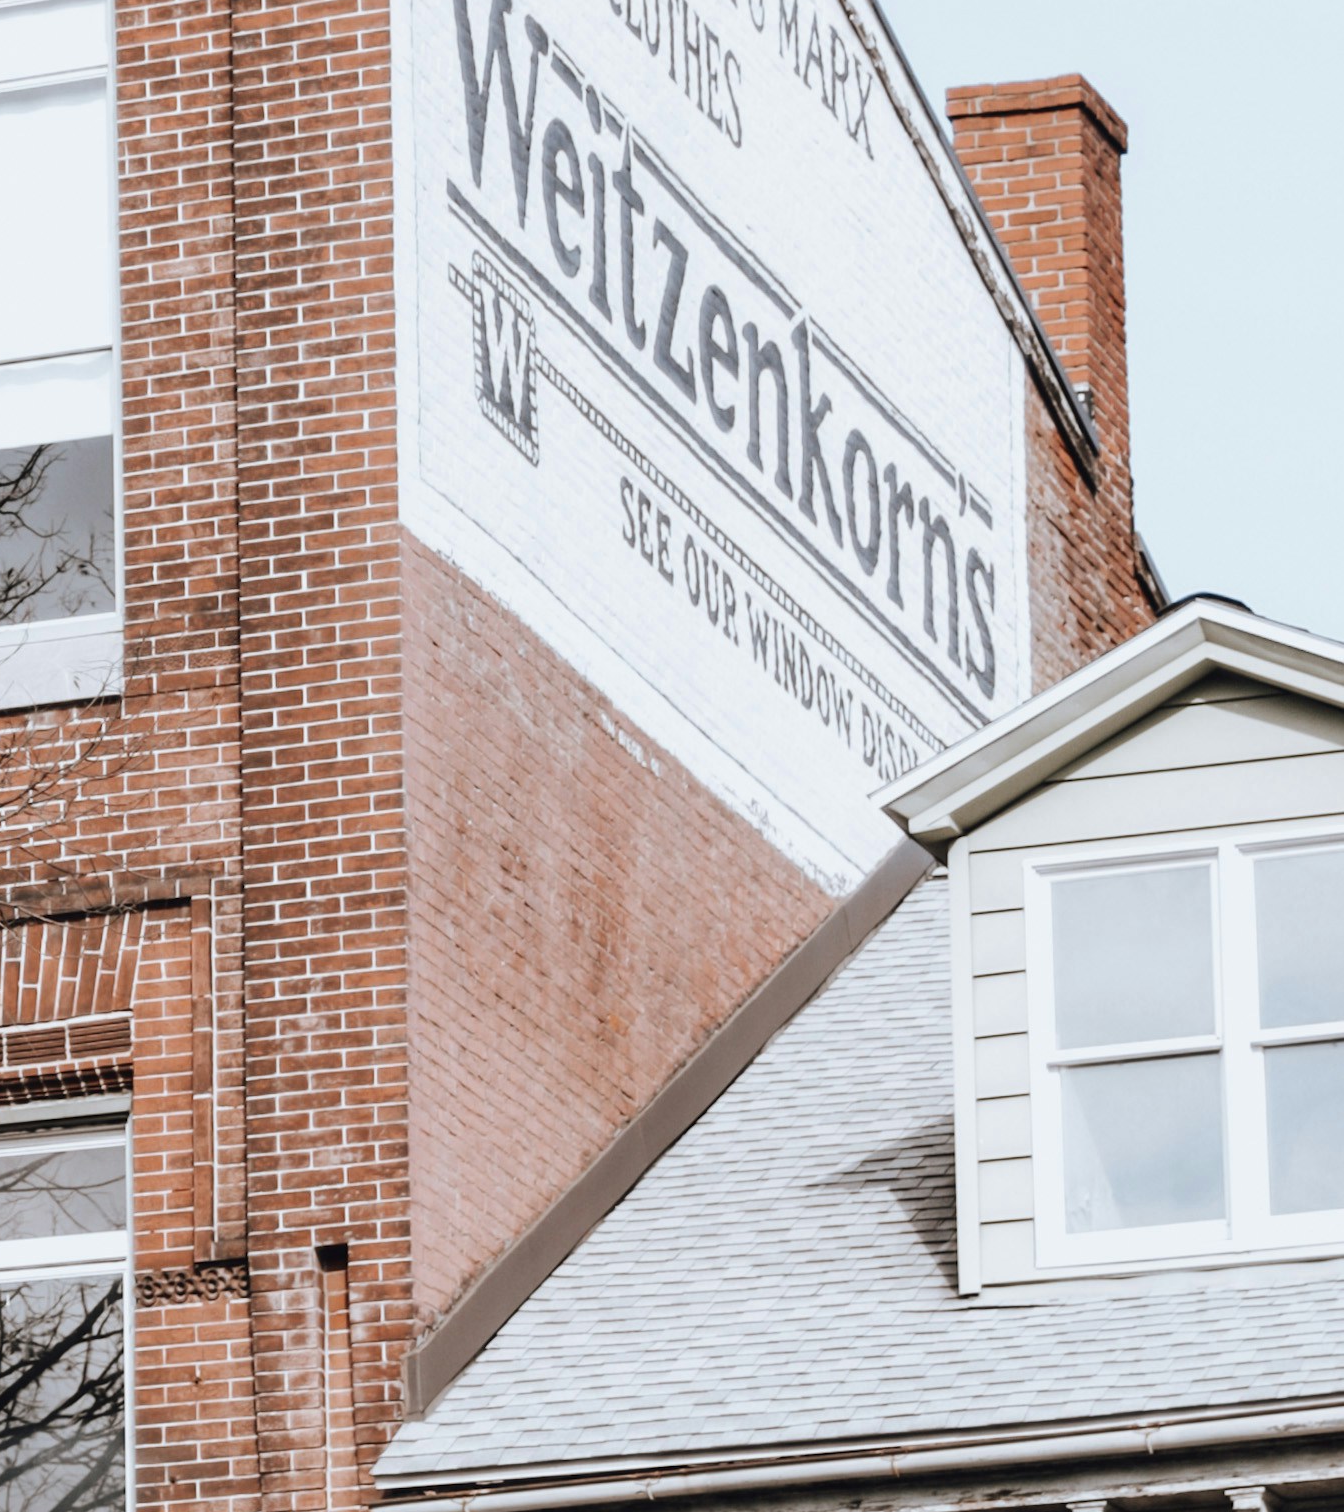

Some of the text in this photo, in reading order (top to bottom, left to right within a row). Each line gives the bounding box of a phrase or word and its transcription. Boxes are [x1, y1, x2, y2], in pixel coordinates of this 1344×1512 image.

[620, 476, 674, 586] SEE
[684, 533, 740, 647] OUR
[744, 590, 854, 750] WINDOW
